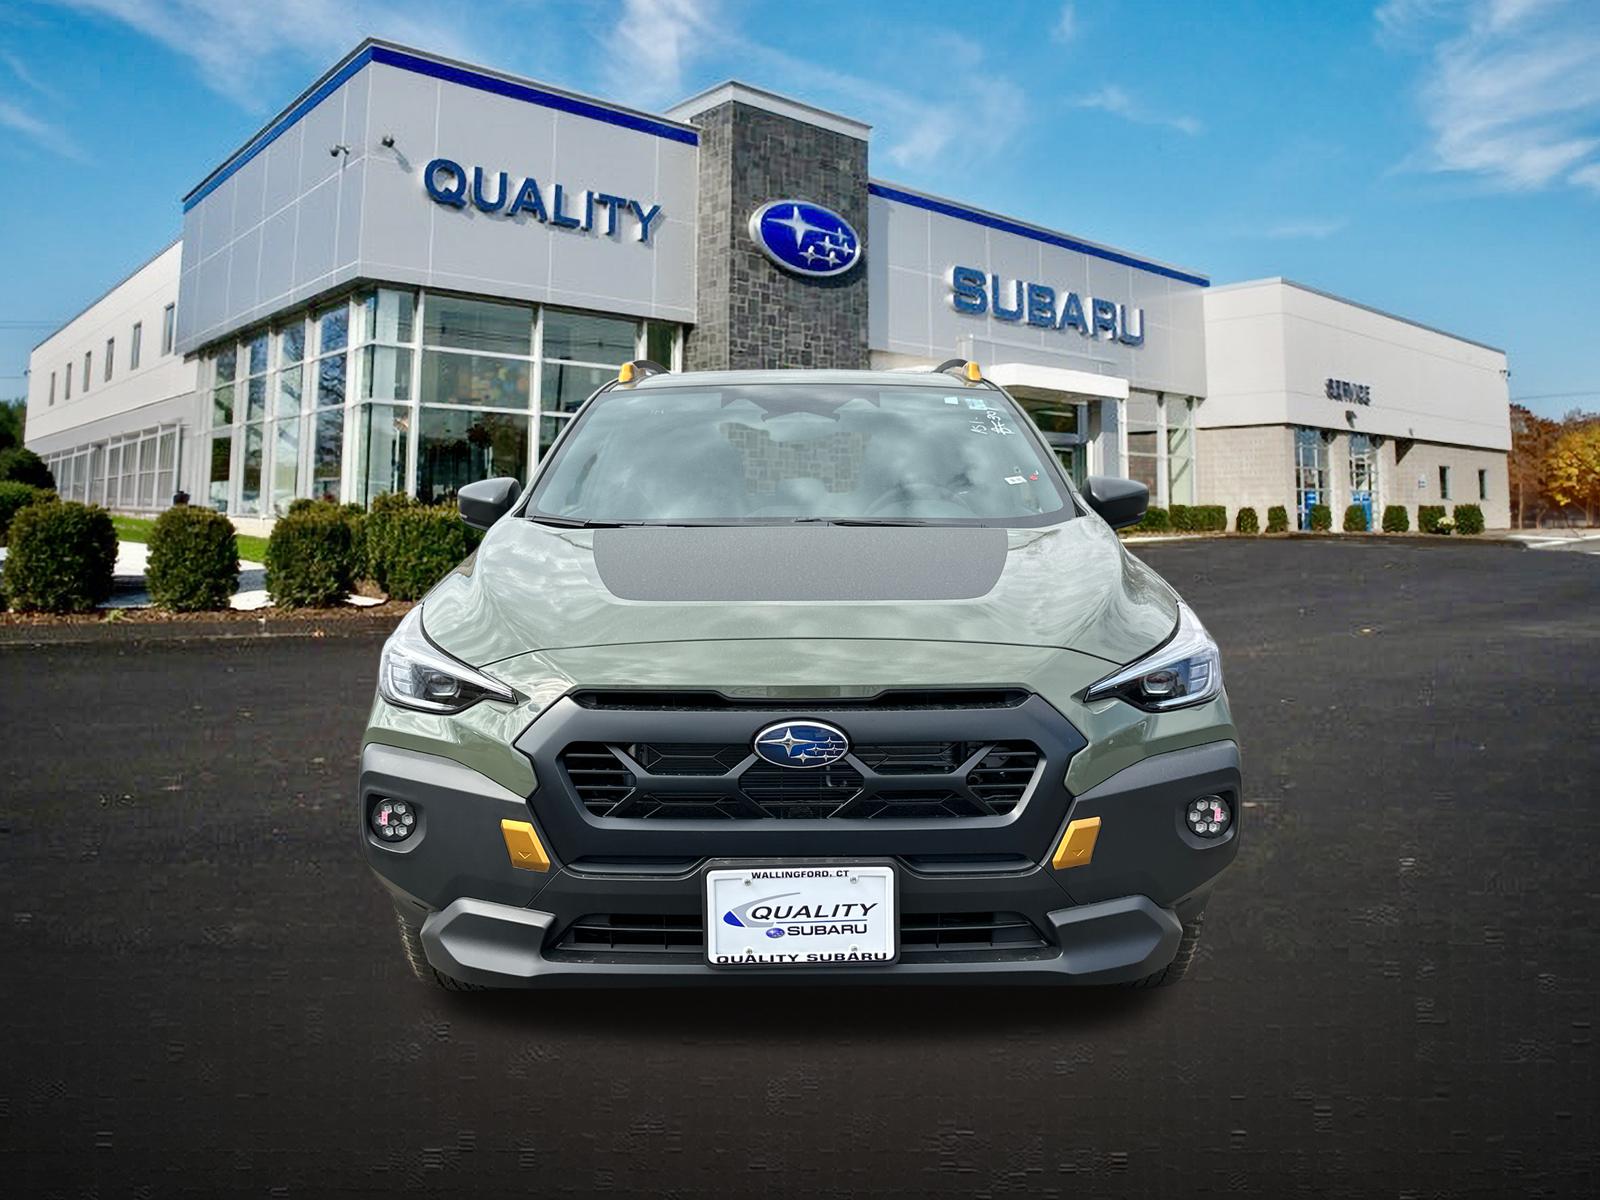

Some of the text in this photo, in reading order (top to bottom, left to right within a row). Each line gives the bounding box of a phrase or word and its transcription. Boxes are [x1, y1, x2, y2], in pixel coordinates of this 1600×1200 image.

[423, 157, 662, 242] QUALITY
[948, 265, 1145, 347] SUBARU
[836, 869, 850, 878] CT
[751, 902, 878, 920] QUALITY
[787, 923, 868, 936] SUBARU
[716, 952, 887, 964] QUALITY SUBARU
